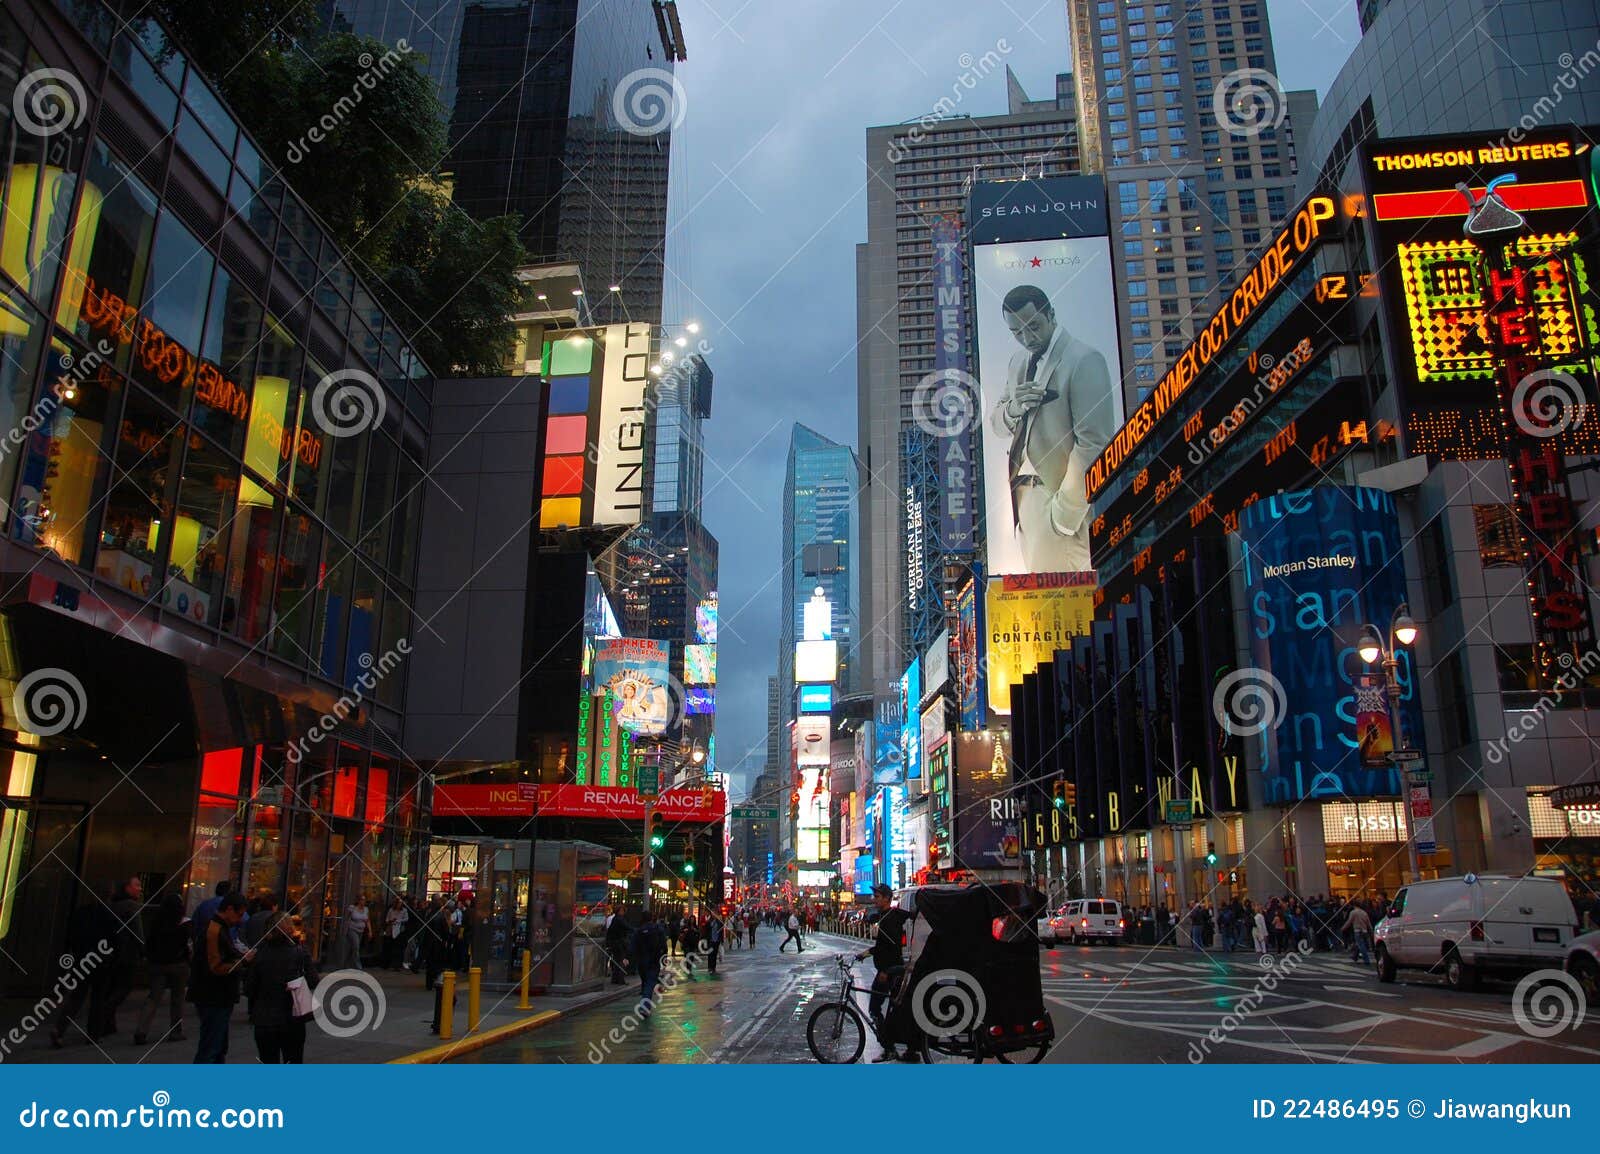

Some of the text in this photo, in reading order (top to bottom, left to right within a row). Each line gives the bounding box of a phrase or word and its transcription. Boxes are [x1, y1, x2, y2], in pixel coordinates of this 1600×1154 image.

[1373, 142, 1570, 172] THOMSON REUTERS
[936, 243, 962, 353] TIMES
[1090, 461, 1106, 493] OIL
[1105, 398, 1155, 484] FUTURES:
[1154, 341, 1200, 422] NYMEX
[1201, 304, 1229, 365] OCT
[1231, 229, 1294, 329] CRUDE
[1294, 197, 1336, 253] OP
[613, 325, 651, 511] INGLOT
[1184, 407, 1204, 443] UTX
[1133, 466, 1149, 496] USB
[1092, 513, 1105, 537] UPS
[906, 484, 917, 610] AMERICAN EAGLE
[915, 501, 924, 590] OUTFITTERS
[1263, 552, 1358, 580] Morgan Stanley
[992, 630, 1084, 644] CONTAGION
[621, 730, 631, 771] OLIVE
[1022, 803, 1079, 849] 1585
[1343, 814, 1408, 831] FOSSIL
